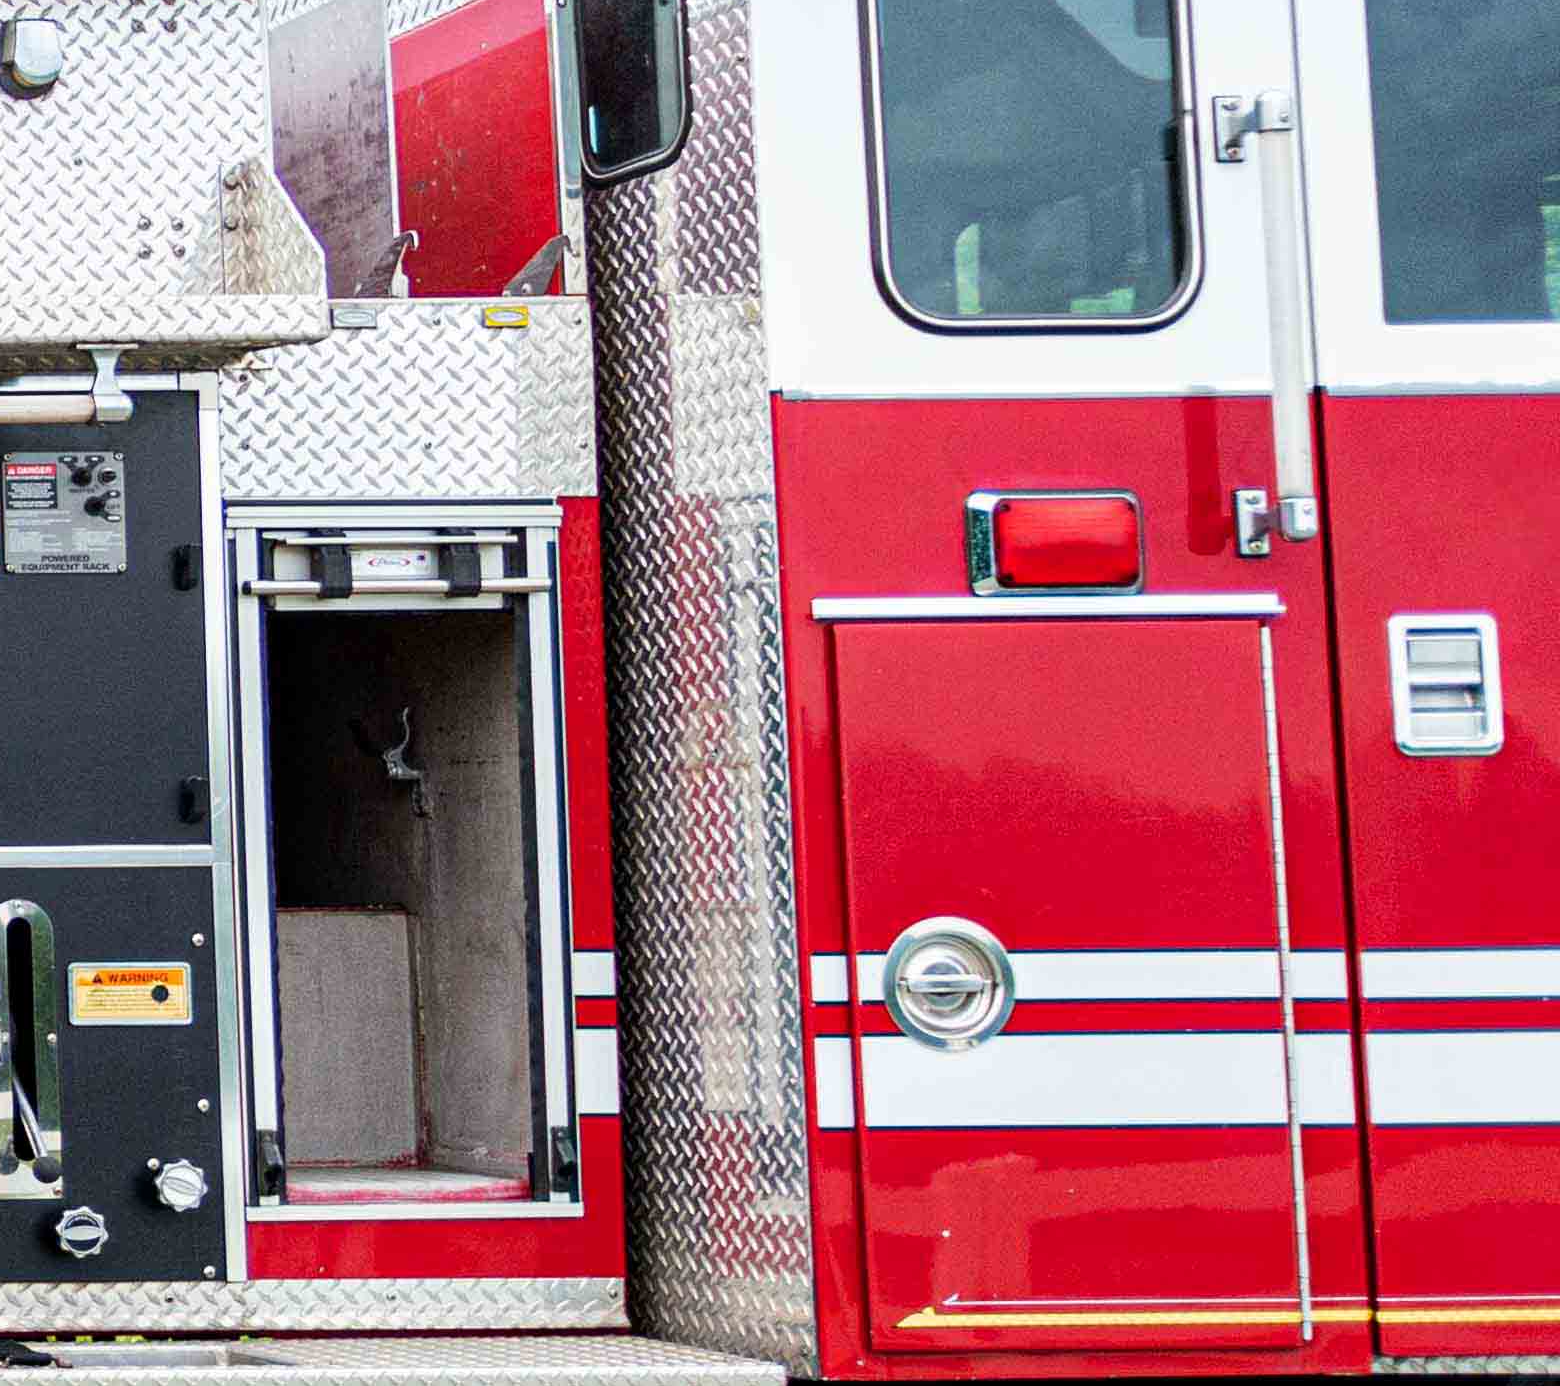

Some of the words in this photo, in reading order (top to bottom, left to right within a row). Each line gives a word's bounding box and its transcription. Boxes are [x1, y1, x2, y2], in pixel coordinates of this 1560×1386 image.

[41, 554, 91, 562] POWERED
[21, 563, 80, 572] EQUIPMENT
[82, 563, 111, 571] RACK
[108, 972, 169, 983] WARNING
